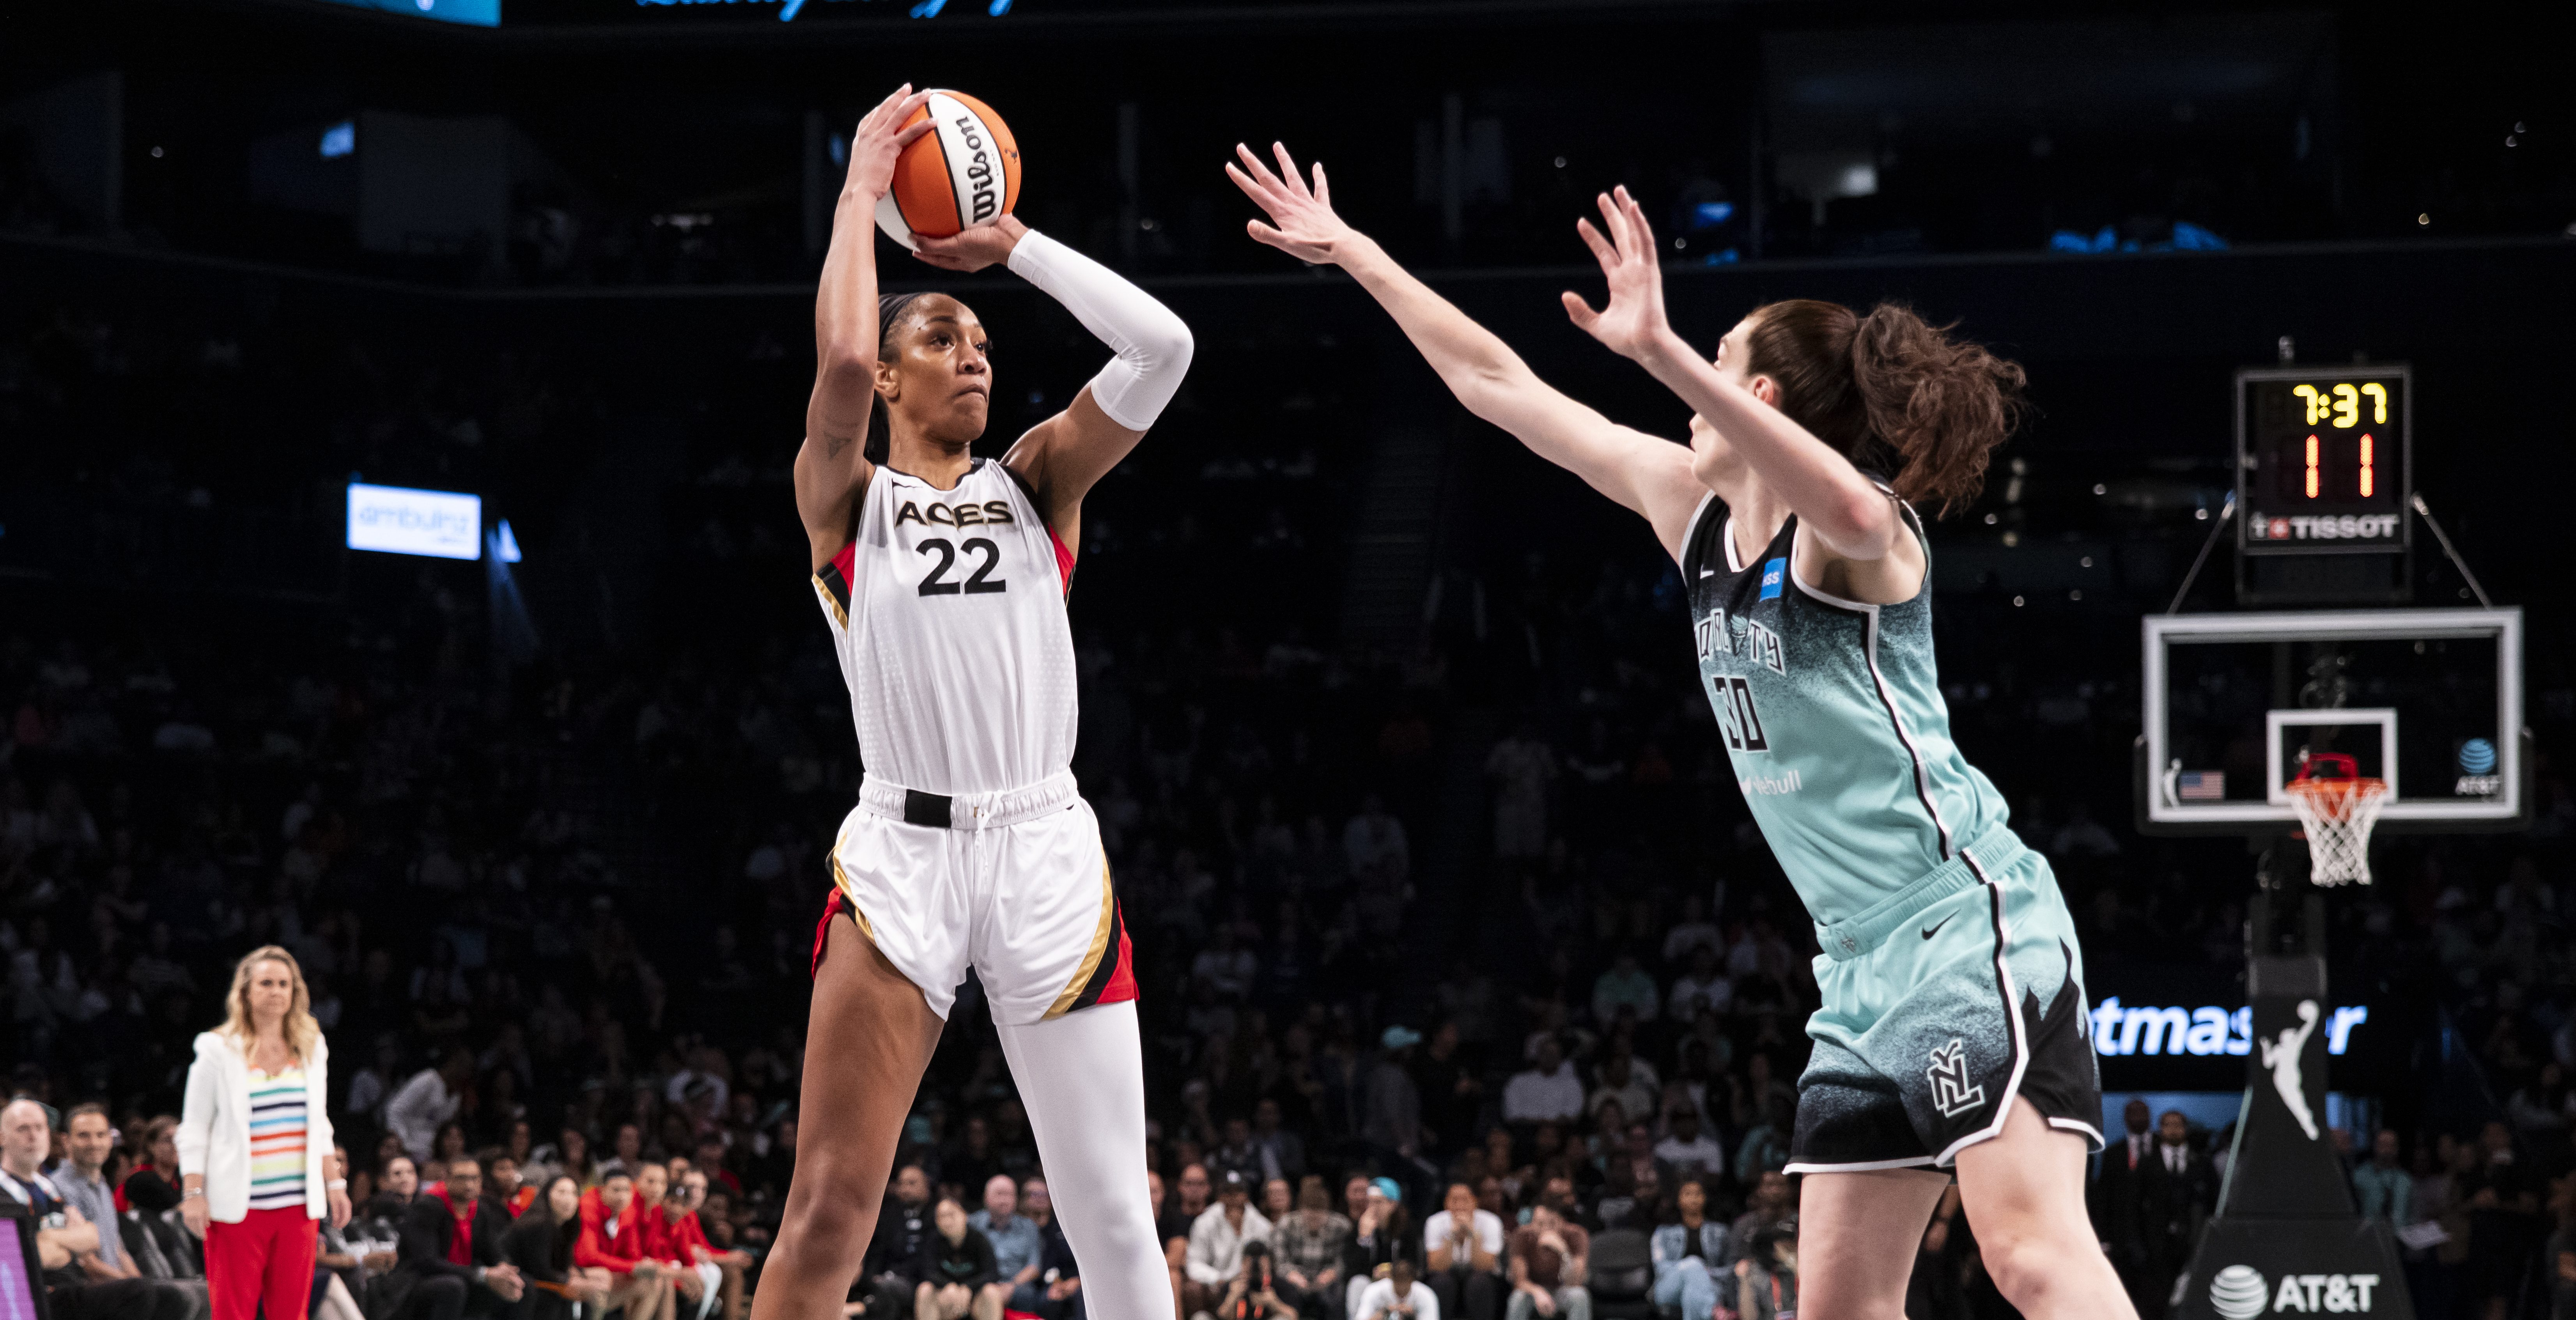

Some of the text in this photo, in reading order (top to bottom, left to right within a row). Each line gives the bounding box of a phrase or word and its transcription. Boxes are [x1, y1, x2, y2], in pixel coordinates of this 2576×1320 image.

[956, 116, 997, 225] Wilson
[2293, 383, 2386, 428] 7:37
[2306, 434, 2373, 498] 11
[896, 500, 1014, 528] ACES
[2289, 514, 2400, 539] TISSOT
[915, 538, 1006, 597] 22
[1711, 675, 1770, 752] 30
[2273, 1274, 2379, 1313] AT&T
